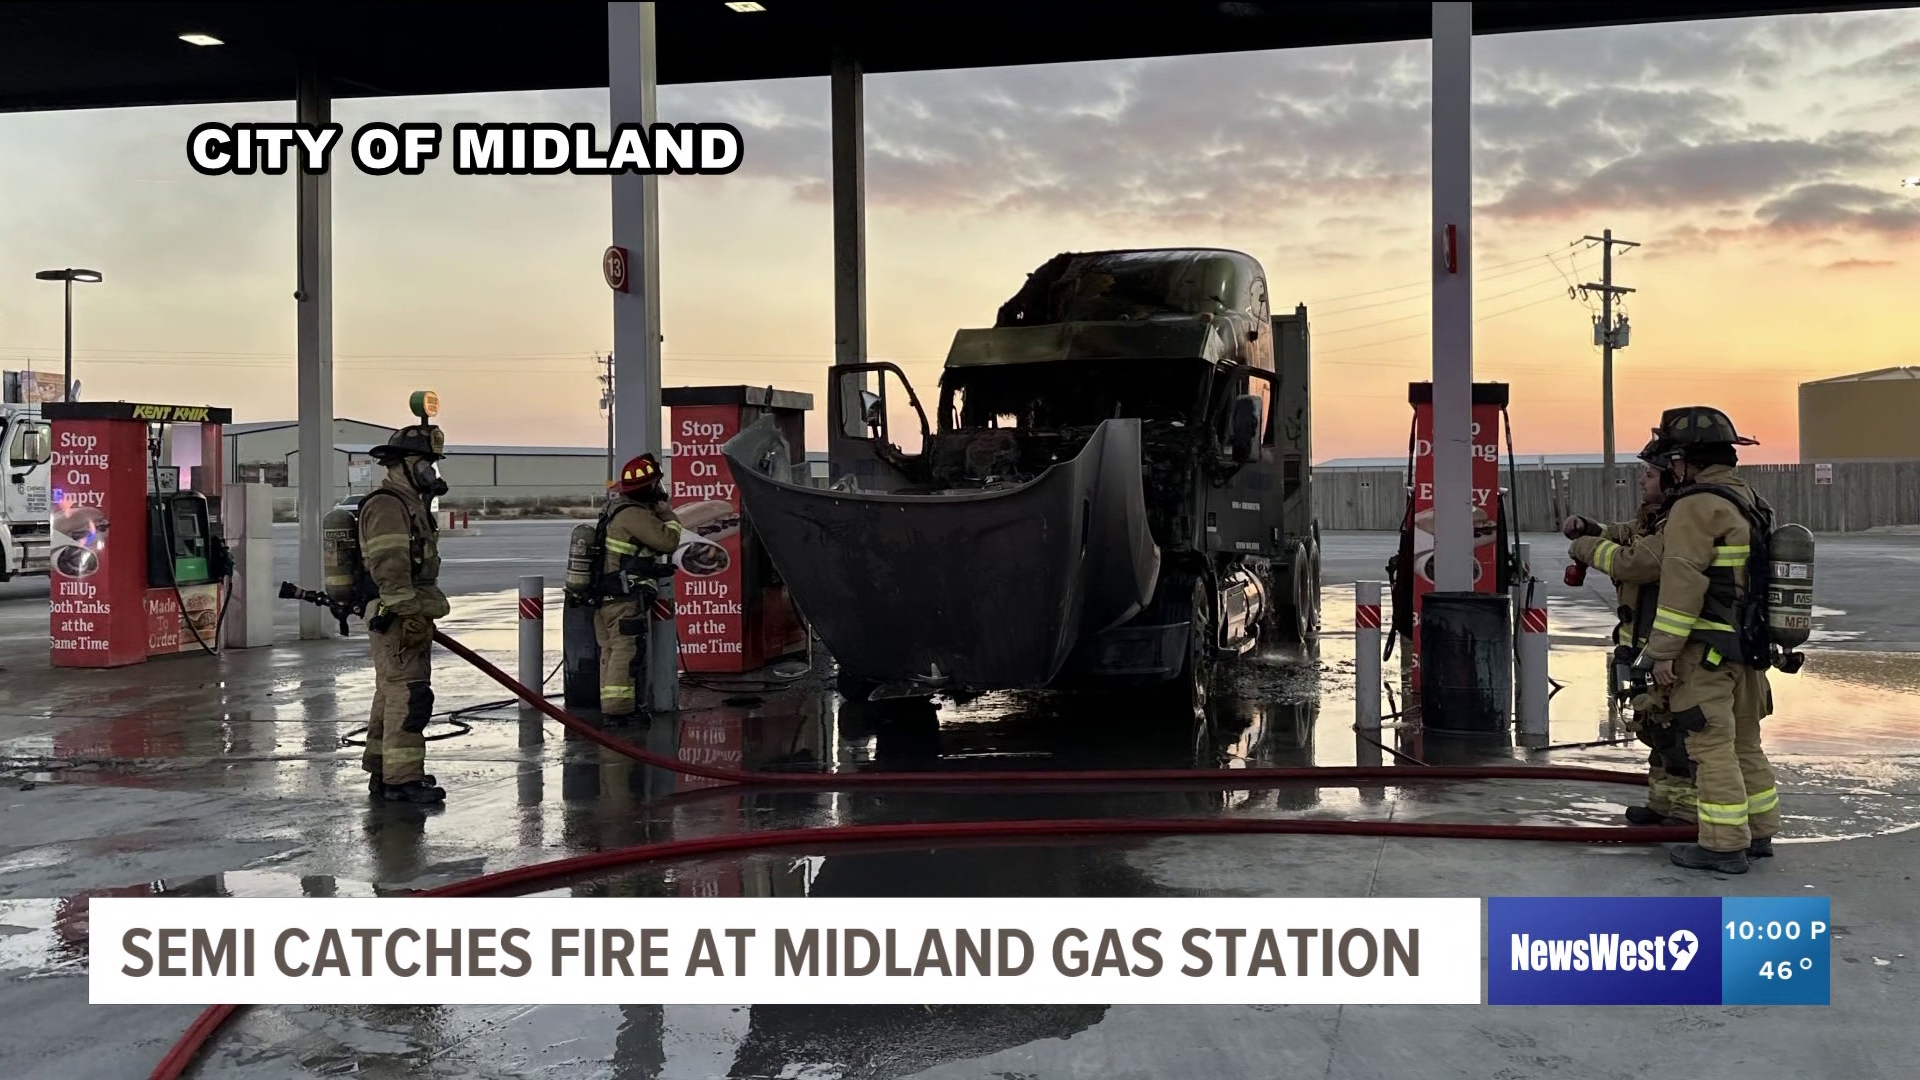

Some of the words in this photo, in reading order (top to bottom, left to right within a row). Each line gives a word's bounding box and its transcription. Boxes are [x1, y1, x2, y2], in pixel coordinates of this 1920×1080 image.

[608, 258, 621, 278] 13
[132, 405, 171, 419] KENT
[172, 407, 210, 421] KWIK
[681, 420, 724, 439] Stop
[60, 432, 97, 450] Stop
[671, 440, 723, 457] Drivin
[50, 450, 109, 469] Driving
[690, 461, 718, 476] On
[67, 470, 90, 485] On
[52, 488, 105, 507] Empty
[673, 481, 736, 500] Empty
[59, 582, 78, 596] Fill
[79, 582, 97, 599] Up
[685, 581, 707, 596] Fill
[708, 581, 728, 598] Up
[75, 600, 111, 614] Tanks
[149, 598, 176, 614] Made
[703, 600, 742, 615] Tanks
[61, 619, 73, 632] at
[74, 618, 94, 632] the
[157, 616, 169, 630] To
[688, 621, 701, 635] at
[703, 619, 726, 634] the
[1785, 616, 1810, 628] MFD
[78, 636, 109, 650] Time
[149, 633, 178, 649] Order
[676, 641, 708, 654] ame
[708, 639, 742, 654] Time
